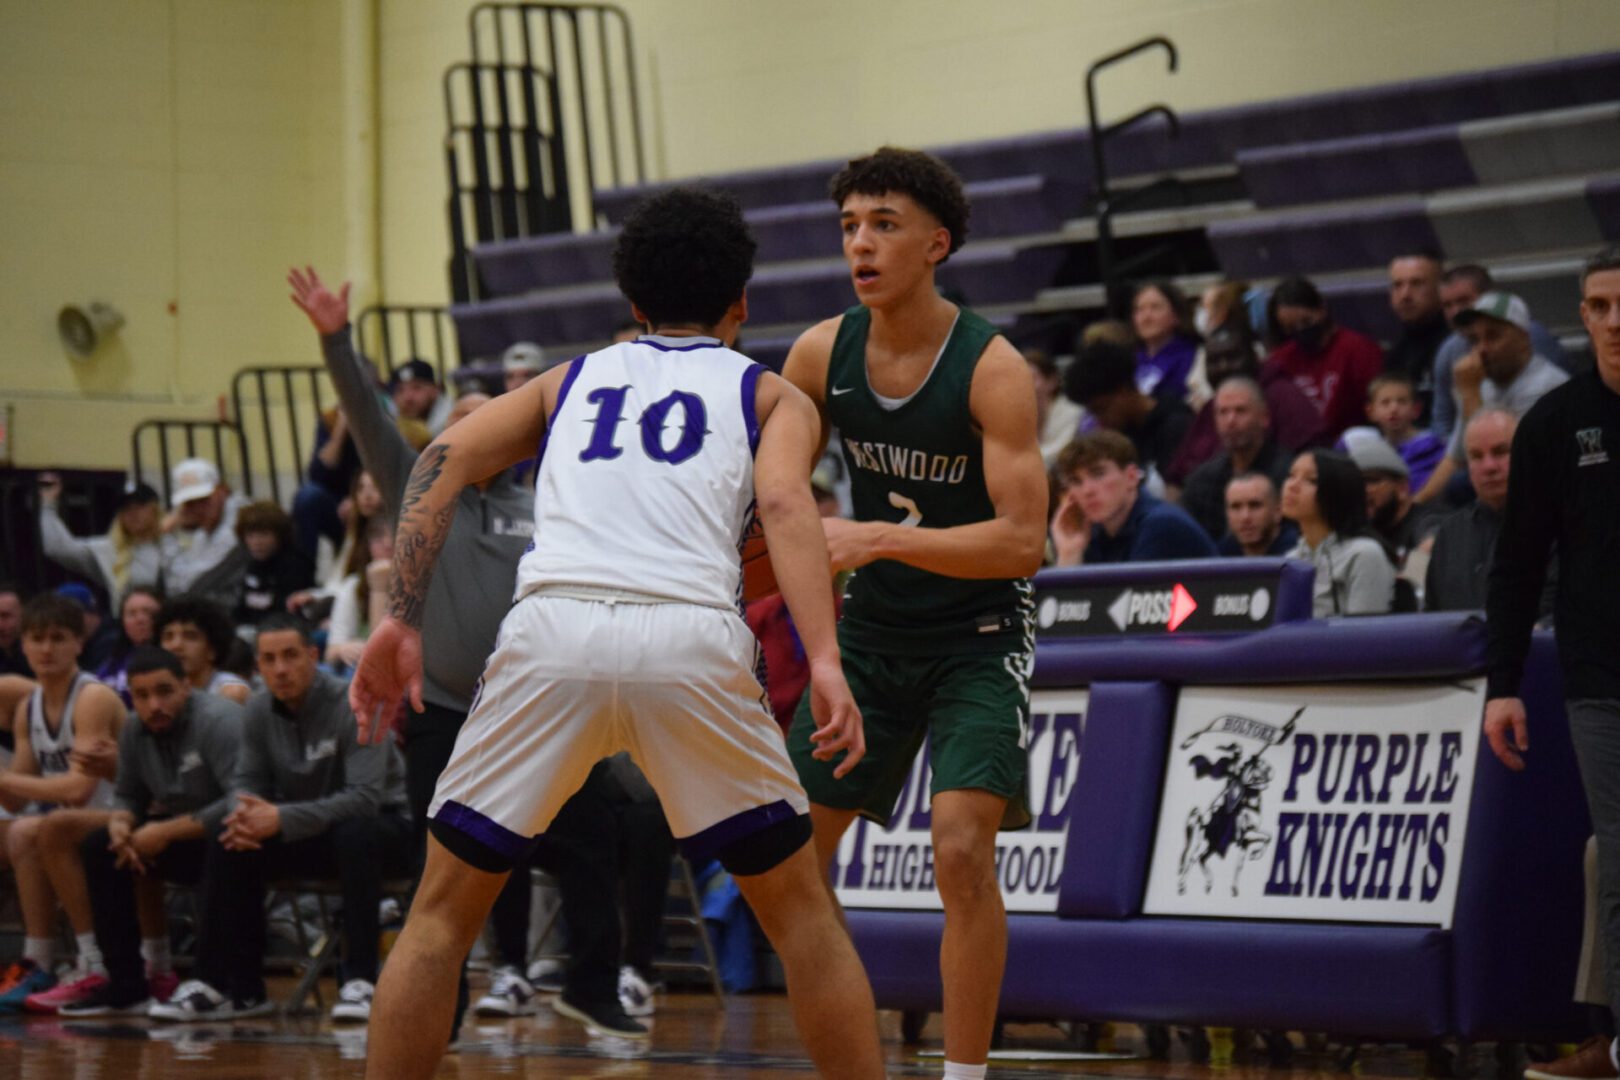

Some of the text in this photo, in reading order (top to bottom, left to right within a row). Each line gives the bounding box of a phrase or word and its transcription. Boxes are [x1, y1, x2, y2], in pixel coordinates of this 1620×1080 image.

[578, 384, 713, 466] 10
[1127, 591, 1173, 625] POSS
[1282, 731, 1463, 804] PURPLE
[867, 844, 936, 891] HIGH
[1263, 811, 1450, 903] KNIGHTS
